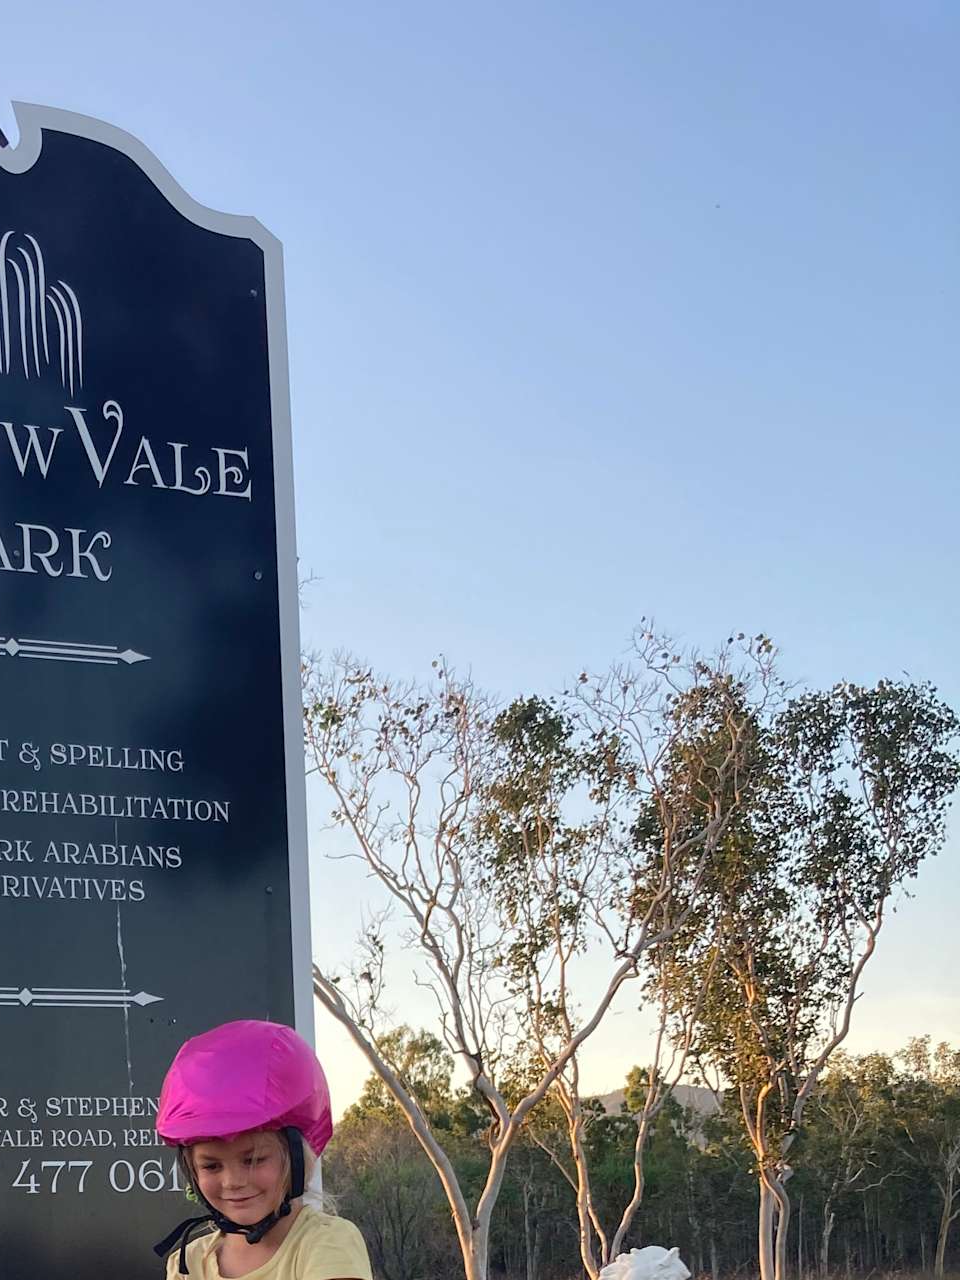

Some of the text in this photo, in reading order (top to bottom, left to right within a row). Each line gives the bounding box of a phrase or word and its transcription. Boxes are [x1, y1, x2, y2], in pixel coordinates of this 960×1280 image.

[18, 742, 42, 772] &
[49, 743, 185, 773] SPELLING
[1, 789, 231, 823] REHABILITATION
[43, 841, 183, 869] ARABIANS
[17, 1097, 38, 1124] &
[45, 1097, 160, 1117] STEPHEN
[51, 1129, 117, 1149] ROAD,
[12, 1158, 93, 1194] 477
[109, 1156, 185, 1193] 061
